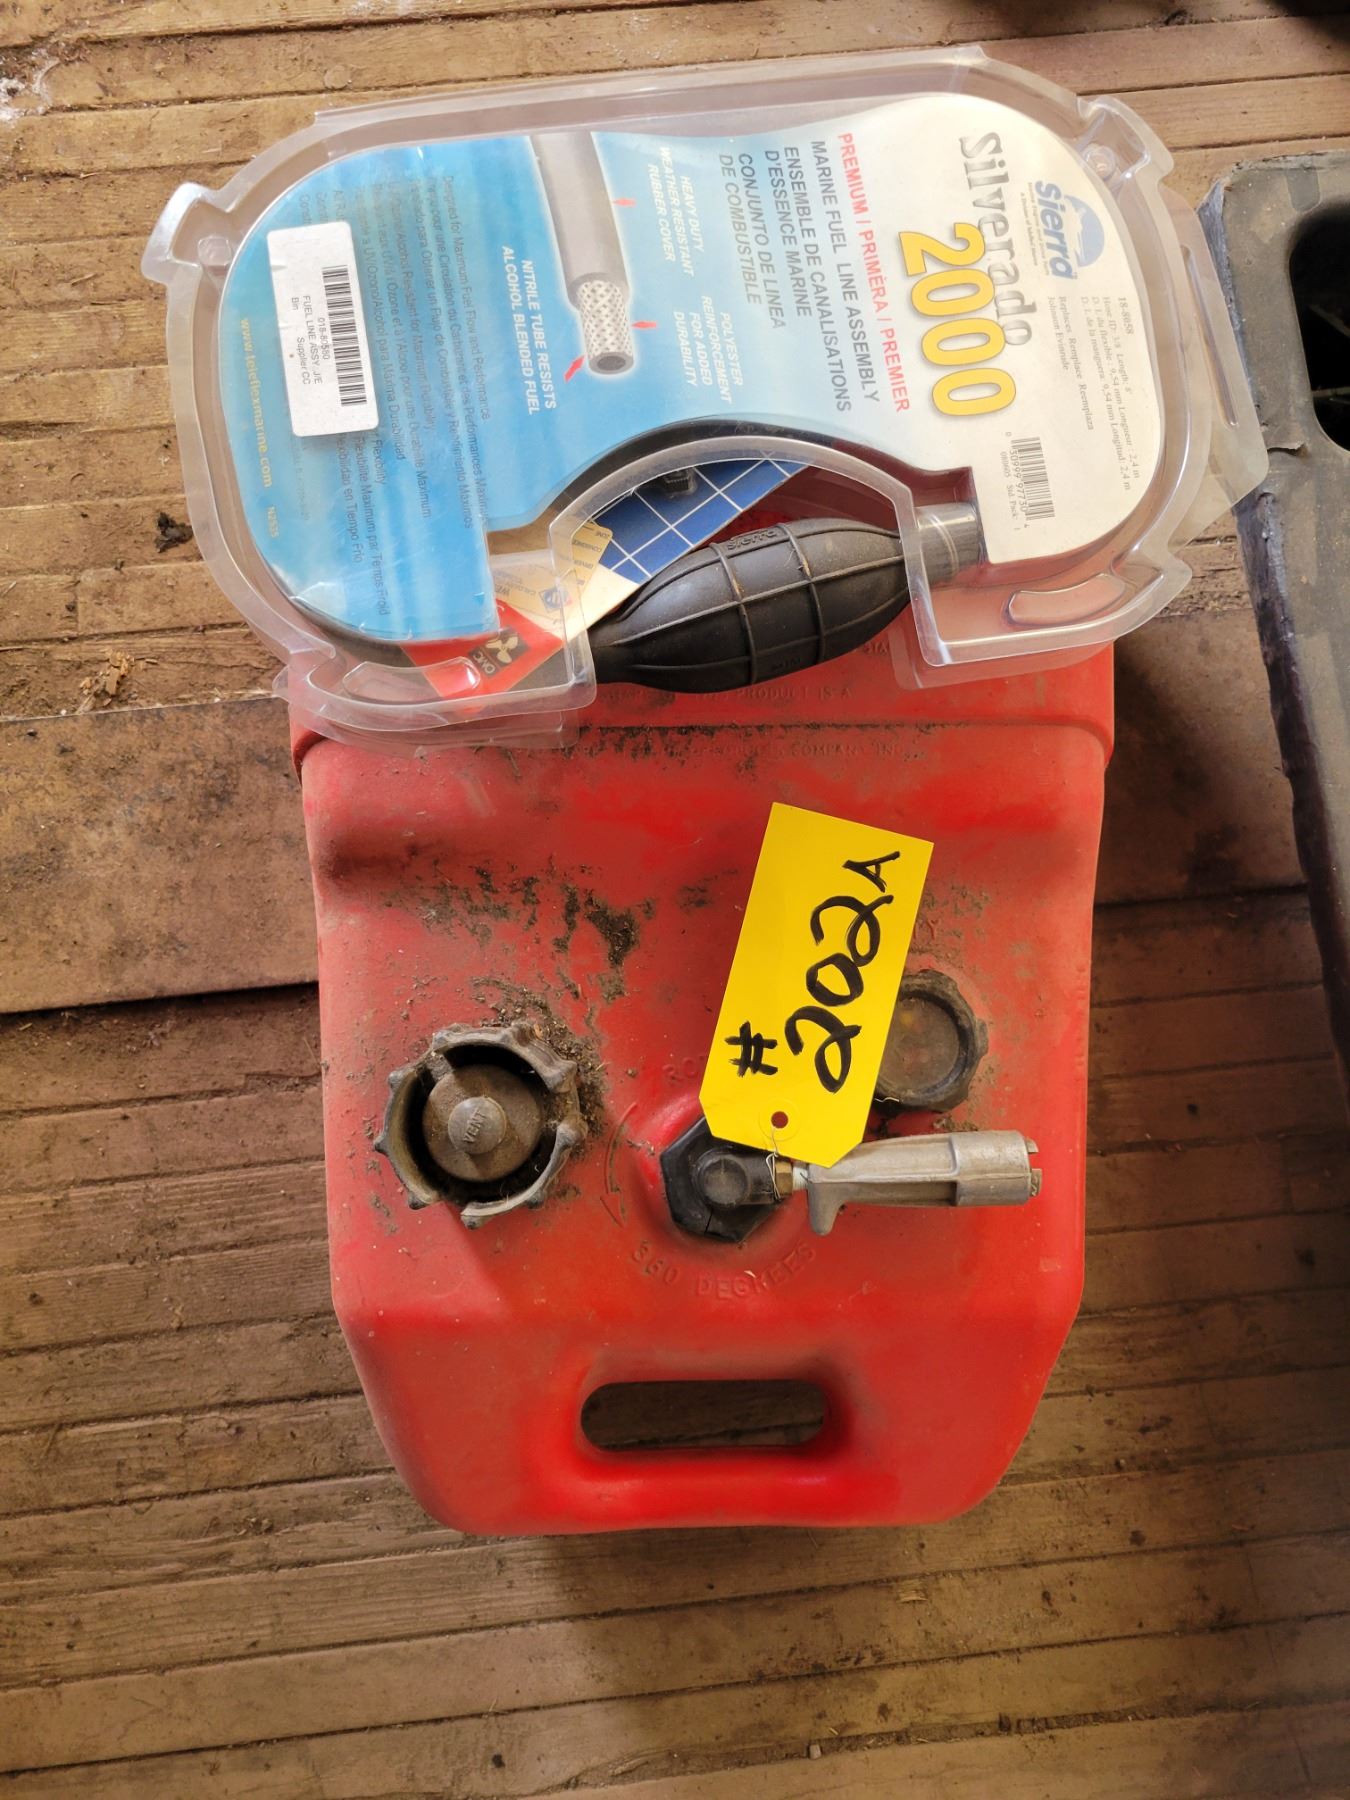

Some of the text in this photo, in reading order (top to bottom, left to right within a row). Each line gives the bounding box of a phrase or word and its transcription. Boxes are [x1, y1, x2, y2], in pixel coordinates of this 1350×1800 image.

[647, 163, 675, 262] RUBBER COVER
[659, 146, 693, 276] WEATHER RESISTANT
[680, 175, 704, 253] HEAVY DUTY
[718, 153, 761, 305] DE COMBUSTIBLE
[737, 152, 785, 328] CONJUNTO DE LINEA
[764, 149, 811, 317] D'ESSENCE MARINE
[959, 132, 1038, 346] Silverado
[452, 237, 469, 283] Maximum
[460, 286, 473, 307] Fuel
[784, 146, 851, 411] ENSEMBLE DE CANALISATIONS
[811, 140, 879, 403] MARINE FUEL LINE ASSEMBLY
[838, 134, 867, 213] PREMIUM
[879, 328, 909, 411] PREMIER
[291, 296, 299, 310] Bin
[295, 336, 308, 369] Supplier
[302, 294, 312, 317] FUEL
[306, 320, 315, 340] LINE
[501, 245, 540, 415] ALCOHOL BLENDED FUEL
[520, 259, 556, 409] NITRILE TUBE RESISTS
[898, 220, 1018, 417] 2000
[1047, 296, 1061, 329] Johnson
[438, 255, 455, 305] Circulation
[447, 308, 458, 320] du
[463, 407, 483, 475] Performances
[673, 310, 697, 386] DURABILITY
[689, 311, 712, 385] FOR ADDED
[701, 295, 731, 404] REINFORCEMENT
[719, 311, 743, 385] POLYESTER
[1056, 296, 1094, 430] Replaces Remplace Reemplaza
[472, 357, 491, 419] Performance
[369, 440, 387, 485] Flexibility
[388, 404, 406, 460] Durabilidad
[344, 488, 353, 500] en
[344, 503, 361, 540] Tiempo
[361, 484, 378, 532] Maximum
[416, 470, 432, 517] Maximum
[366, 534, 378, 550] par
[472, 651, 497, 675] OMC
[463, 1110, 488, 1144] VENT
[696, 1241, 817, 1299] DEGREES
